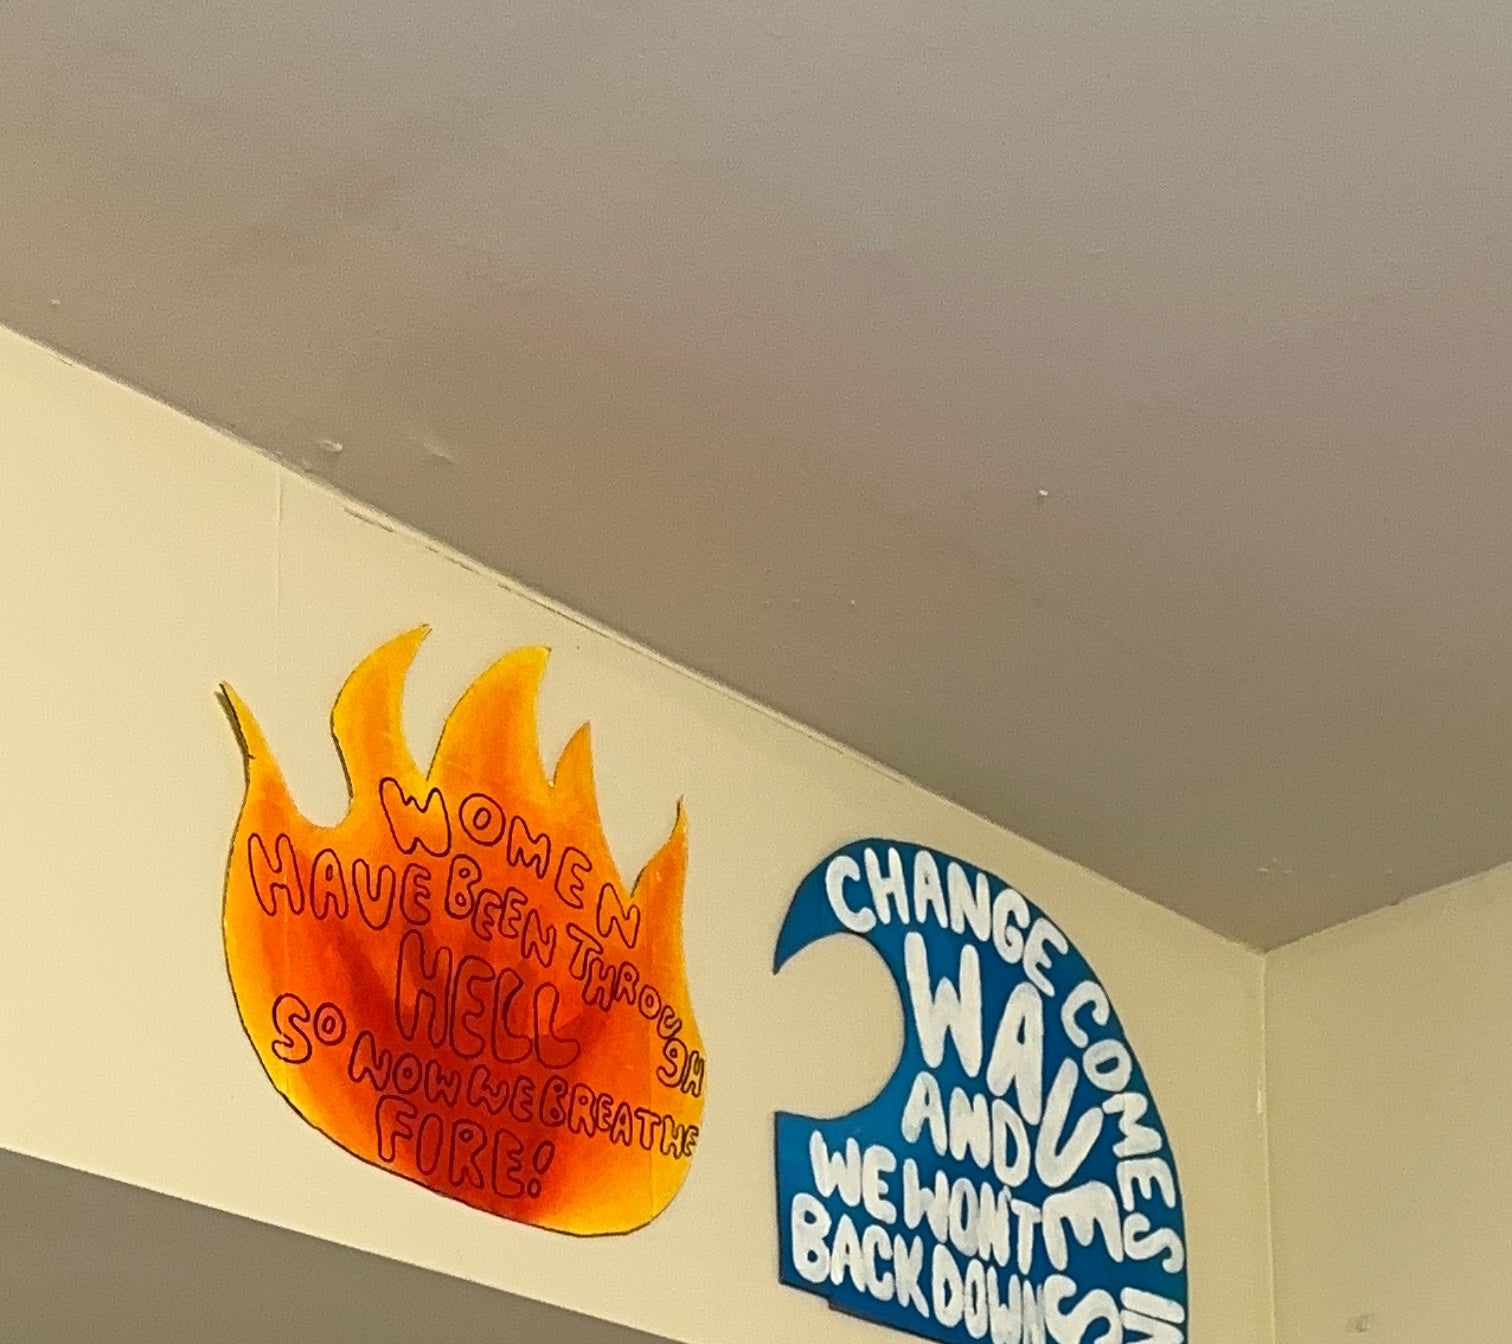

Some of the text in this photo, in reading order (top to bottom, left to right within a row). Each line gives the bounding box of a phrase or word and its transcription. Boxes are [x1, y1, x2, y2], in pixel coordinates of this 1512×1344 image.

[247, 832, 432, 931] HAVE
[445, 854, 558, 967] BEEN
[378, 776, 640, 950] WOMEN
[395, 929, 581, 1070] HELL
[824, 846, 1069, 997] CHANGE
[1060, 980, 1185, 1274] COMES
[272, 993, 699, 1160] SO NOW WE BREATHE
[901, 1070, 1031, 1187] AND
[375, 1094, 556, 1200] FIRE!
[808, 1127, 898, 1225] WE
[790, 1192, 930, 1319] BACK
